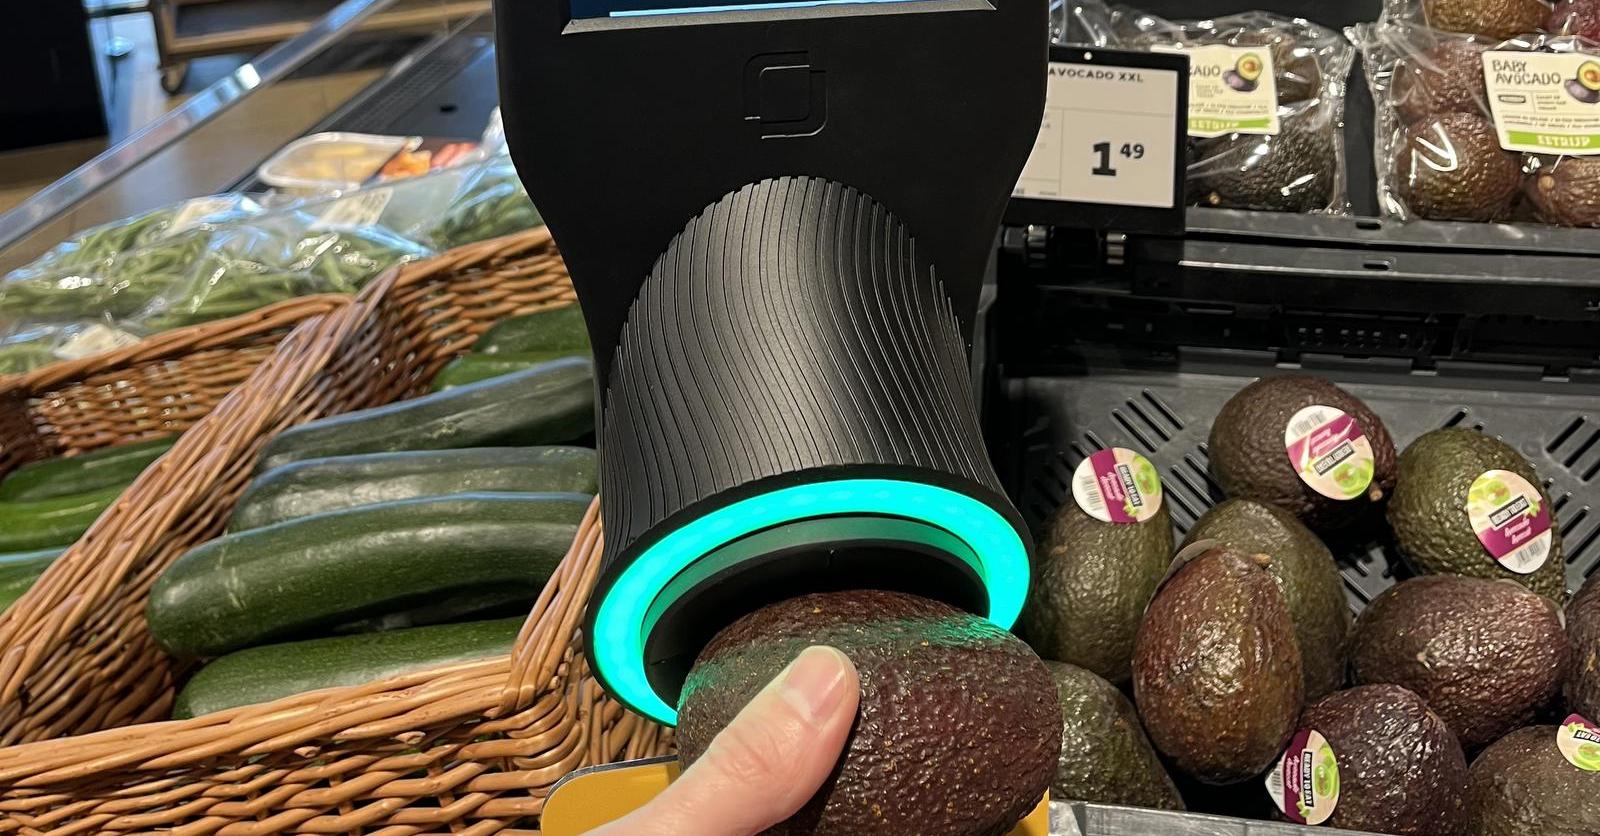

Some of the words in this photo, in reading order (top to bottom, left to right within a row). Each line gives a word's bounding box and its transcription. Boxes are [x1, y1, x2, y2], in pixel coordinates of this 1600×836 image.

[1492, 60, 1526, 72] BABY
[1049, 68, 1114, 80] AVOCADO
[1119, 73, 1143, 82] XXL
[1496, 73, 1560, 85] AVOCADO
[1092, 142, 1116, 176] 1
[1120, 143, 1144, 159] 49
[1303, 779, 1311, 789] TO
[1304, 790, 1312, 805] EAT
